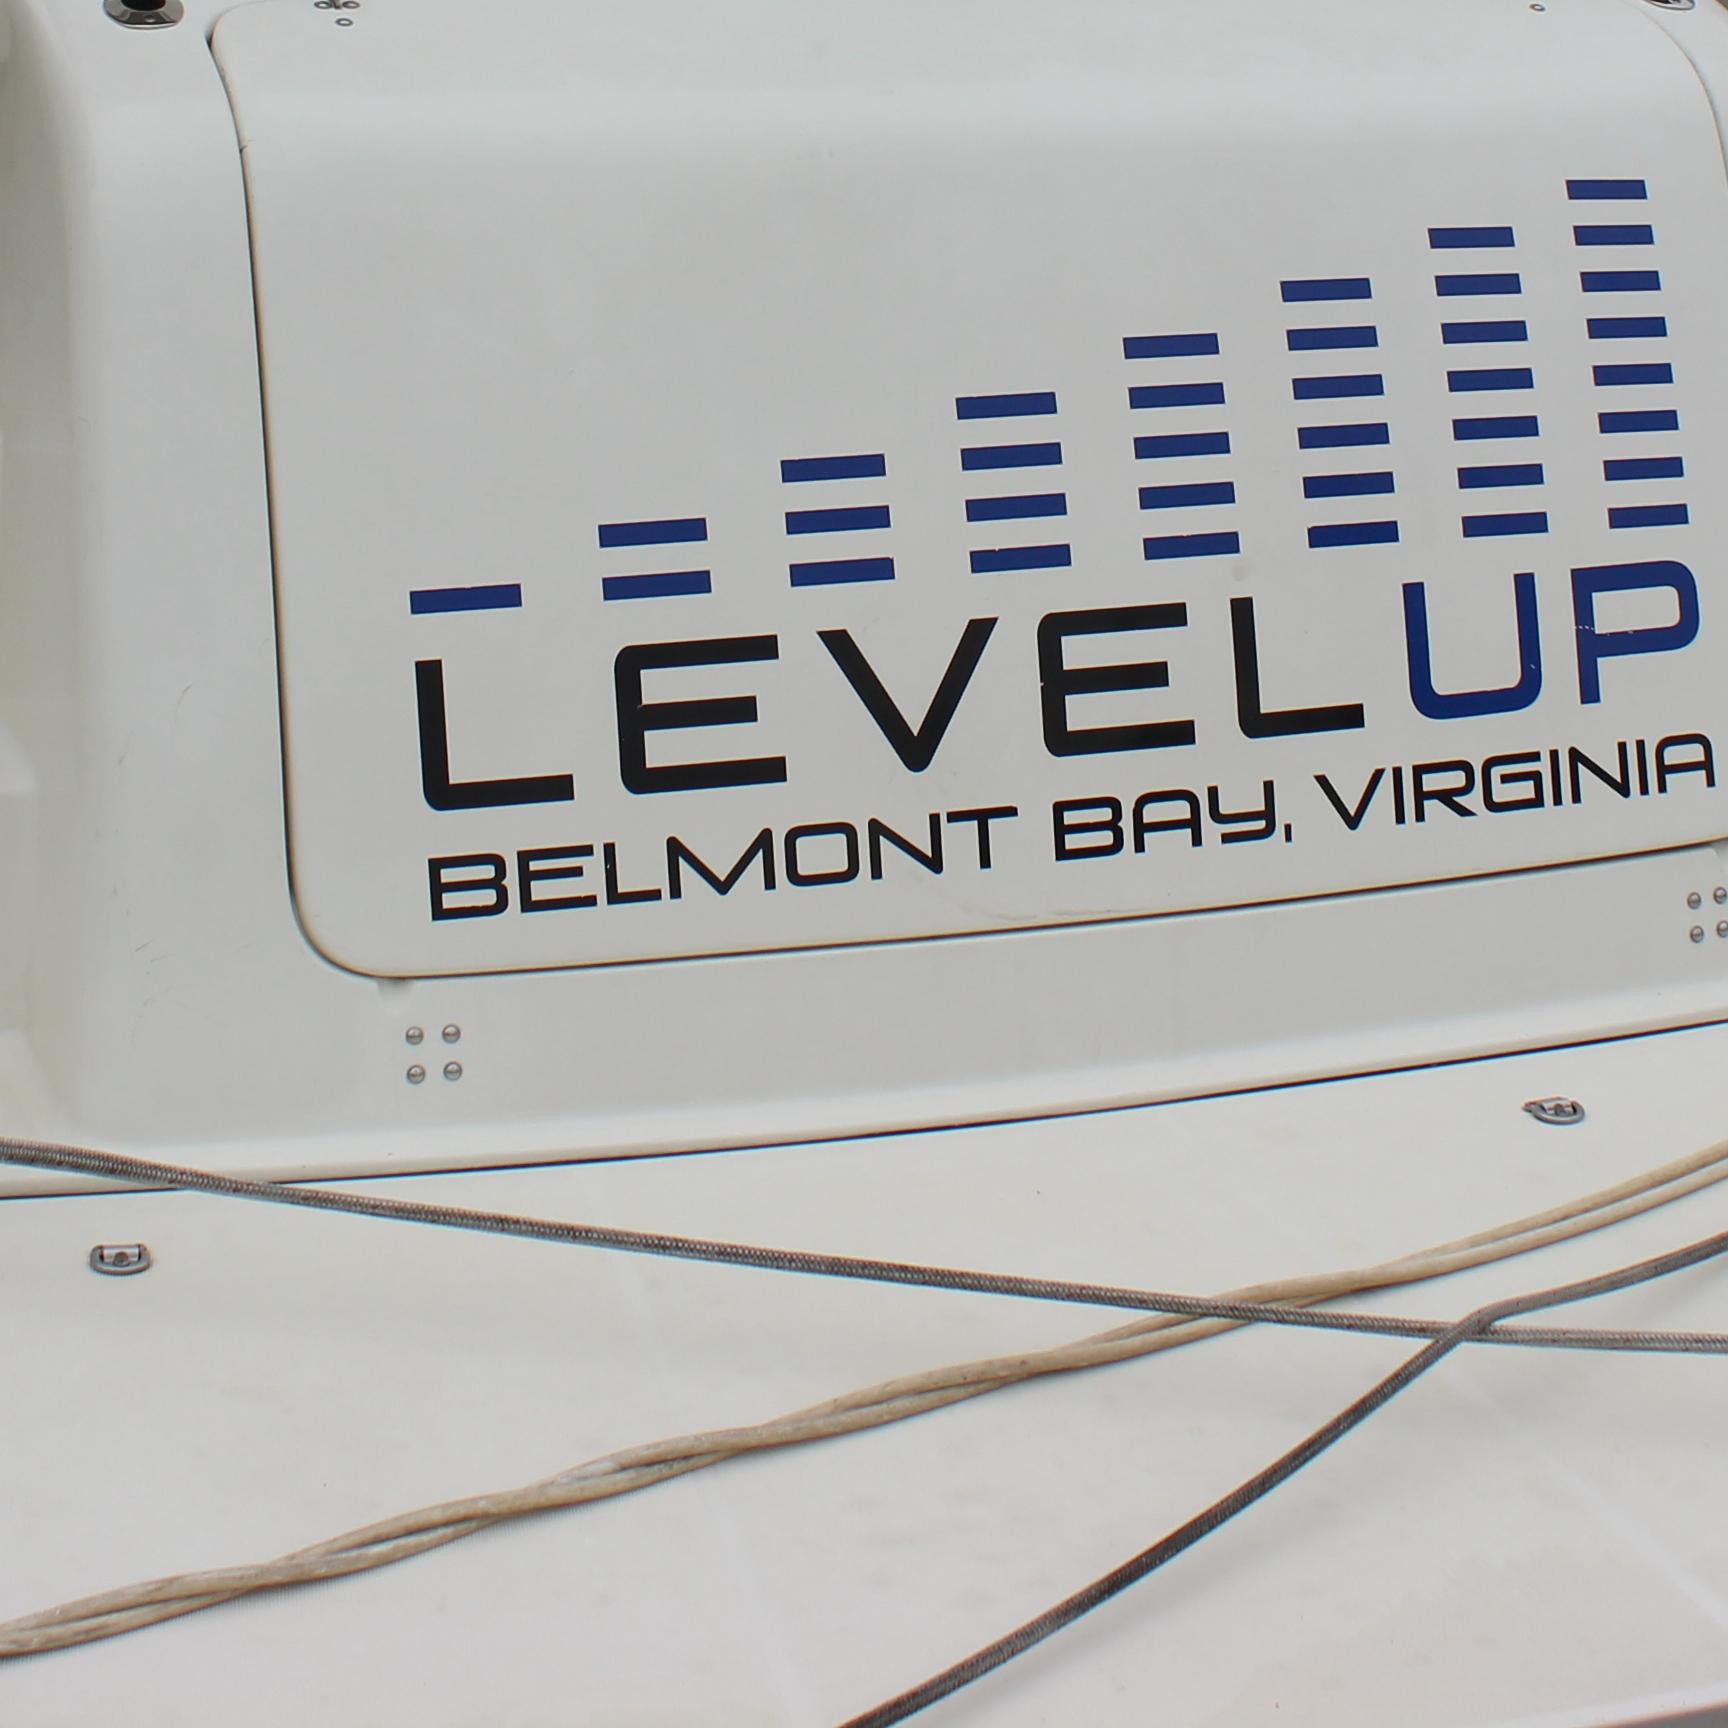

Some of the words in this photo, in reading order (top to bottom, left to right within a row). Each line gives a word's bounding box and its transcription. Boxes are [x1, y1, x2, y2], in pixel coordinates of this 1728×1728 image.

[426, 805, 1020, 923] BELMONT
[1051, 778, 1295, 863] BAY,
[1312, 732, 1717, 832] VIRGINIA
